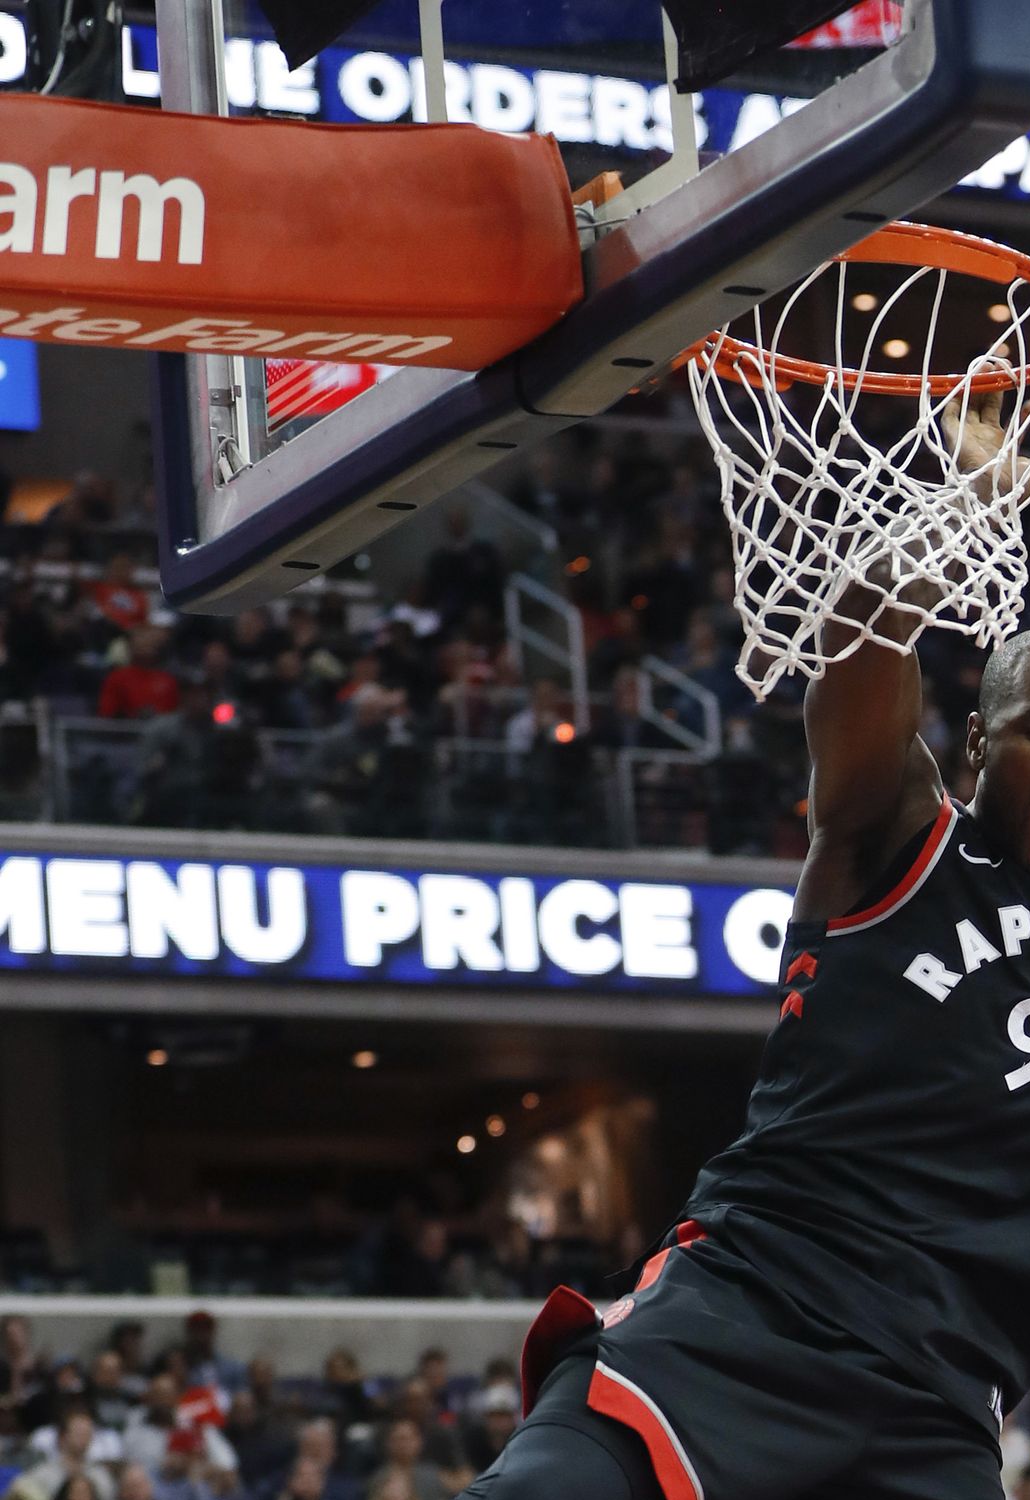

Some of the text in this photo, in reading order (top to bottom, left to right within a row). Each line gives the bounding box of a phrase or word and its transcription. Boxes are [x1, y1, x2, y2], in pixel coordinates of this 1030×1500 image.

[728, 92, 815, 154] A
[123, 317, 453, 359] Farm
[341, 869, 698, 979] PRICE
